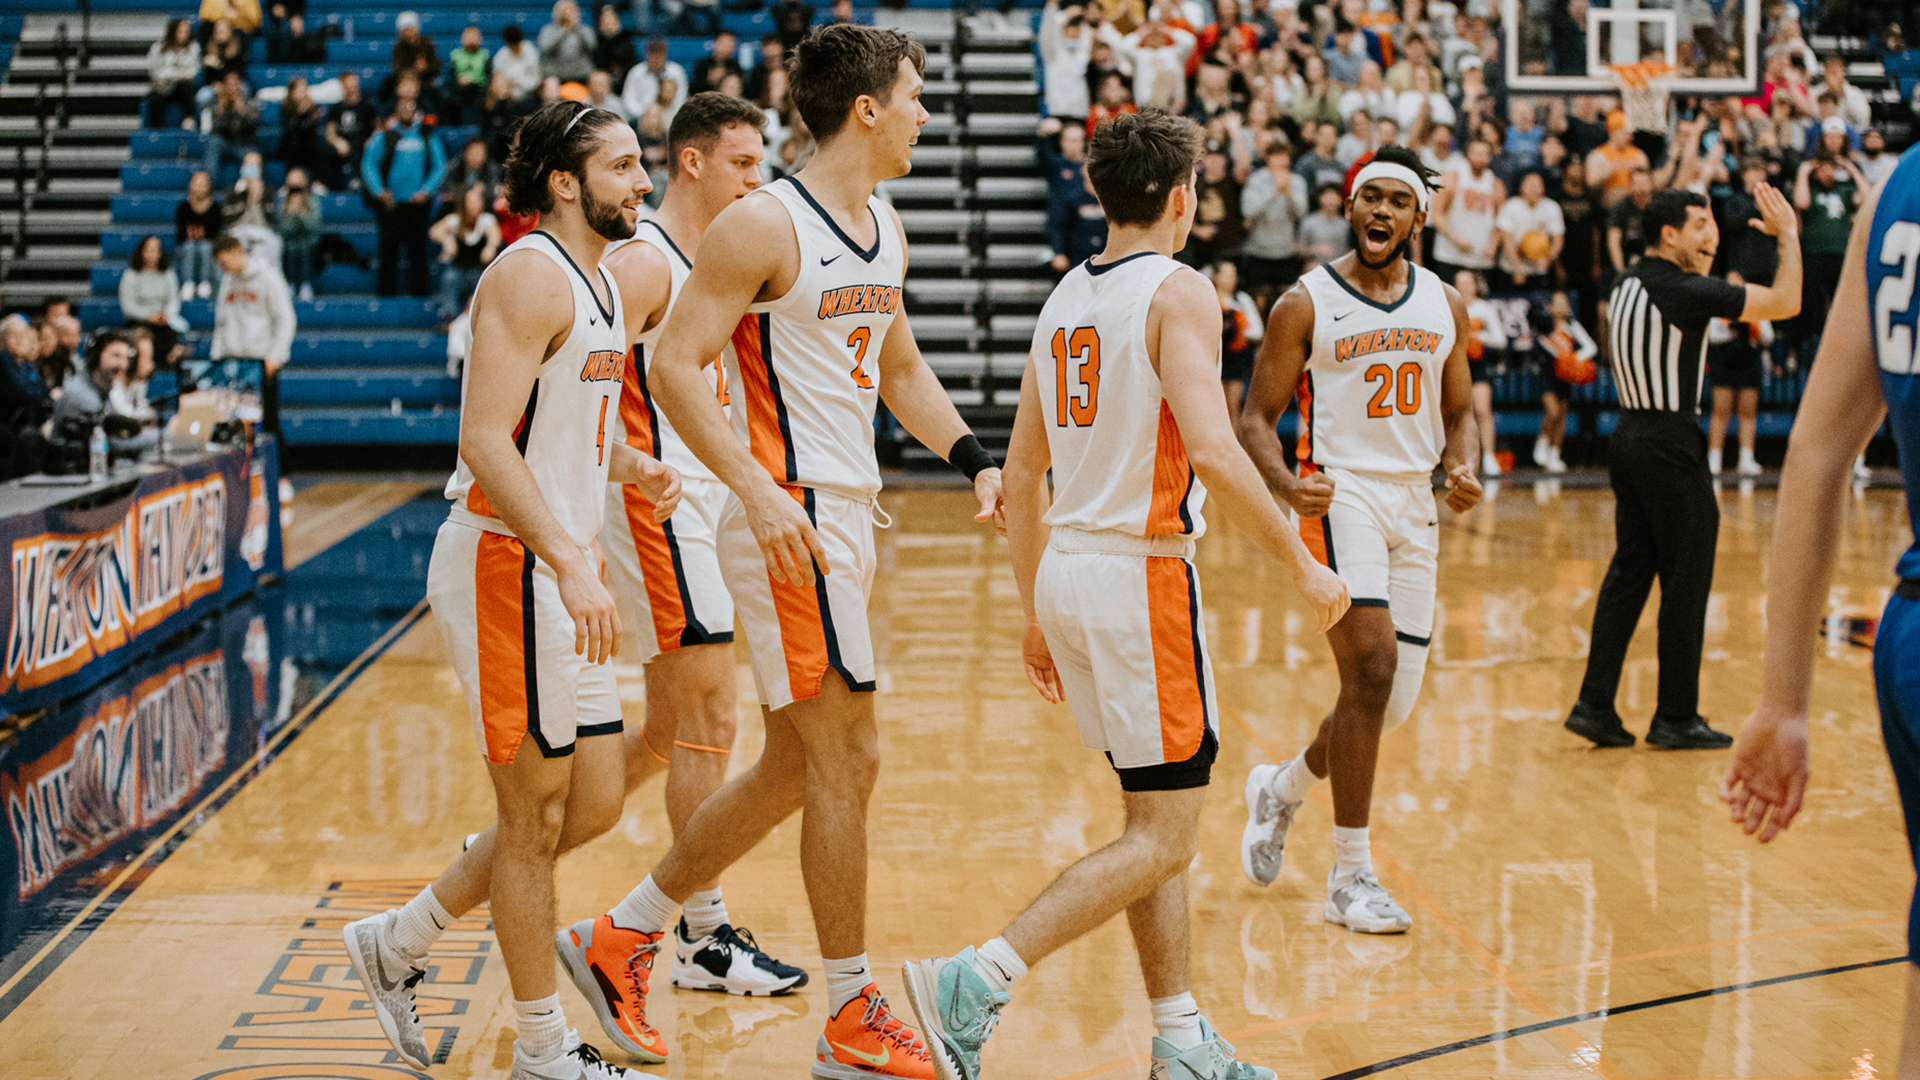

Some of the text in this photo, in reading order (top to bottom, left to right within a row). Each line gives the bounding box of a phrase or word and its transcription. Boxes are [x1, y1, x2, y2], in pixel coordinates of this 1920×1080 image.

[1875, 220, 1920, 375] 2
[847, 326, 875, 389] 2
[1051, 325, 1101, 428] 13
[1335, 327, 1444, 363] WHEATON
[1364, 362, 1422, 419] 20
